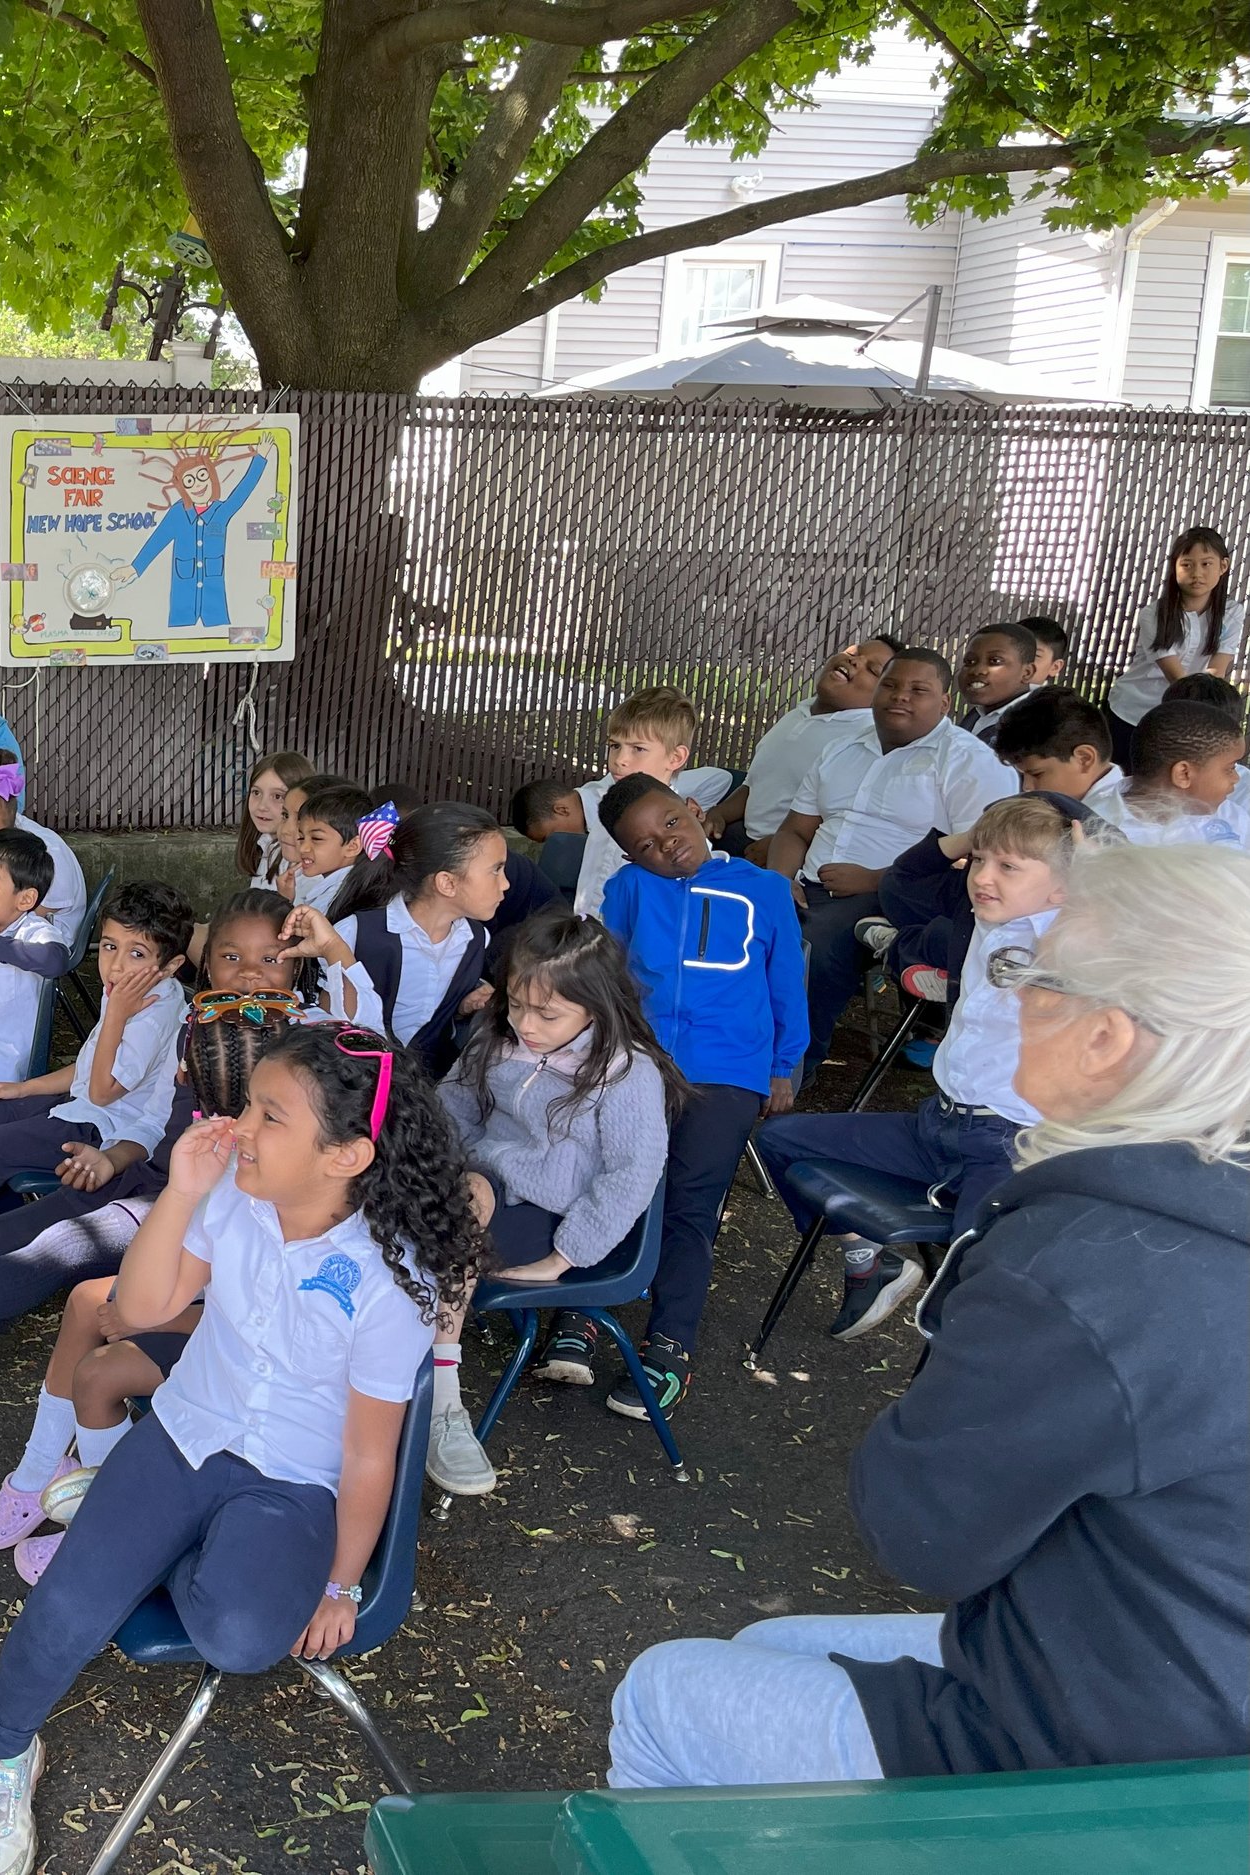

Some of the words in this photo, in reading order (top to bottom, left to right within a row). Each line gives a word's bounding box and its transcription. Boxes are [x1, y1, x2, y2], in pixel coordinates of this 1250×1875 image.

[47, 466, 115, 486] SCIENCE
[64, 488, 103, 507] FAIR
[26, 515, 61, 534] NEW
[65, 513, 102, 533] HOPE
[106, 511, 157, 531] SCHOOL
[40, 629, 68, 638] PLASMA
[345, 1263, 359, 1292] SCHOOL
